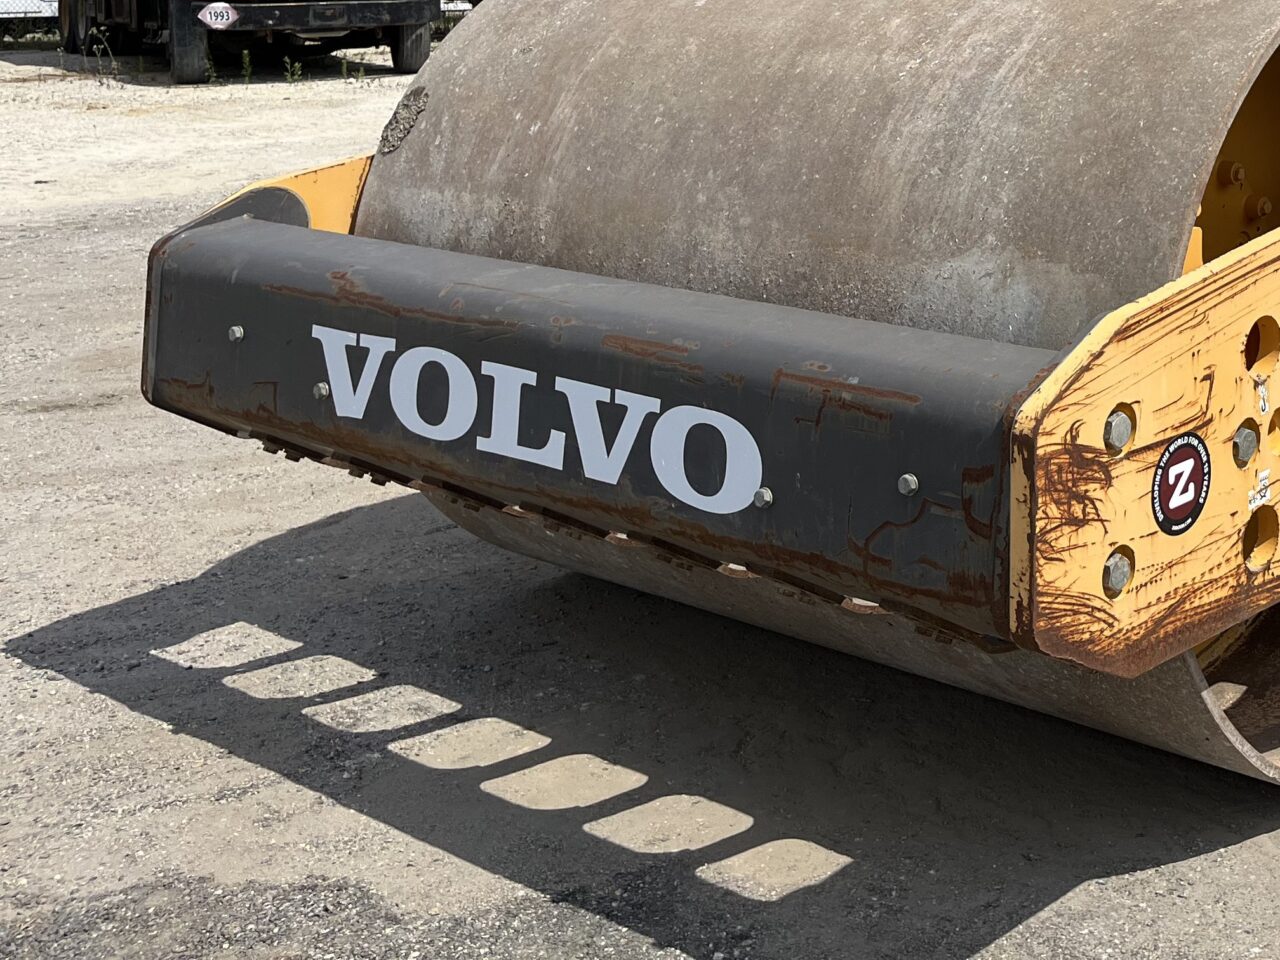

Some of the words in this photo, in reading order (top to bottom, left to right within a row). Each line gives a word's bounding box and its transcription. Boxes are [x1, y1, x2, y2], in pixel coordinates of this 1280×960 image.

[208, 11, 231, 22] 1993
[311, 324, 763, 514] VOLVO
[1168, 436, 1189, 453] WORLD
[1188, 436, 1199, 447] FOR
[1160, 451, 1170, 467] THE
[1198, 443, 1208, 463] OVER
[1169, 458, 1195, 509] Z
[1198, 474, 1209, 504] YEARS
[1154, 468, 1164, 522] DEVELOPING
